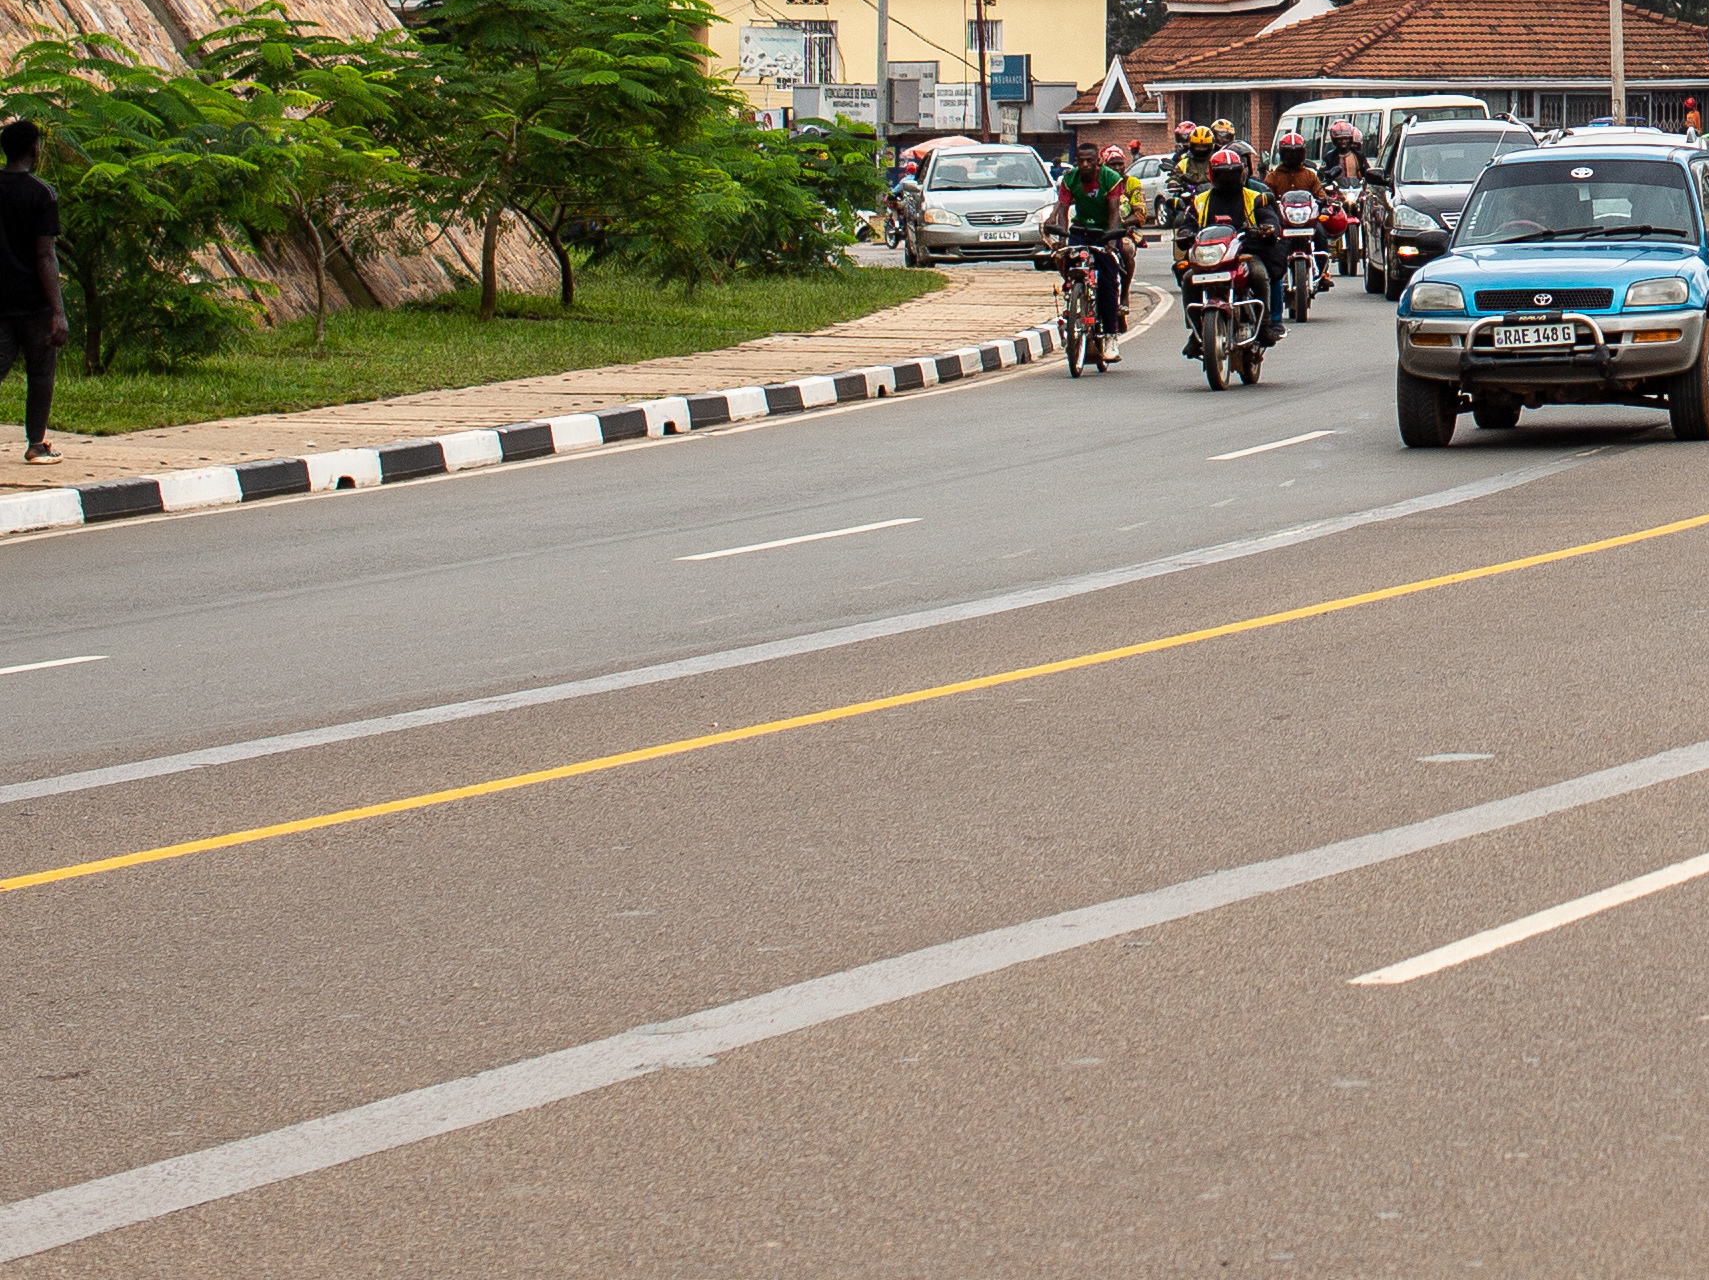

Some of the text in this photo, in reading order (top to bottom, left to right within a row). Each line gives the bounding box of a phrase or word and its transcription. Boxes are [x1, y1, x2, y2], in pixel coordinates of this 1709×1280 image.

[1503, 325, 1572, 346] RAE 148 G
